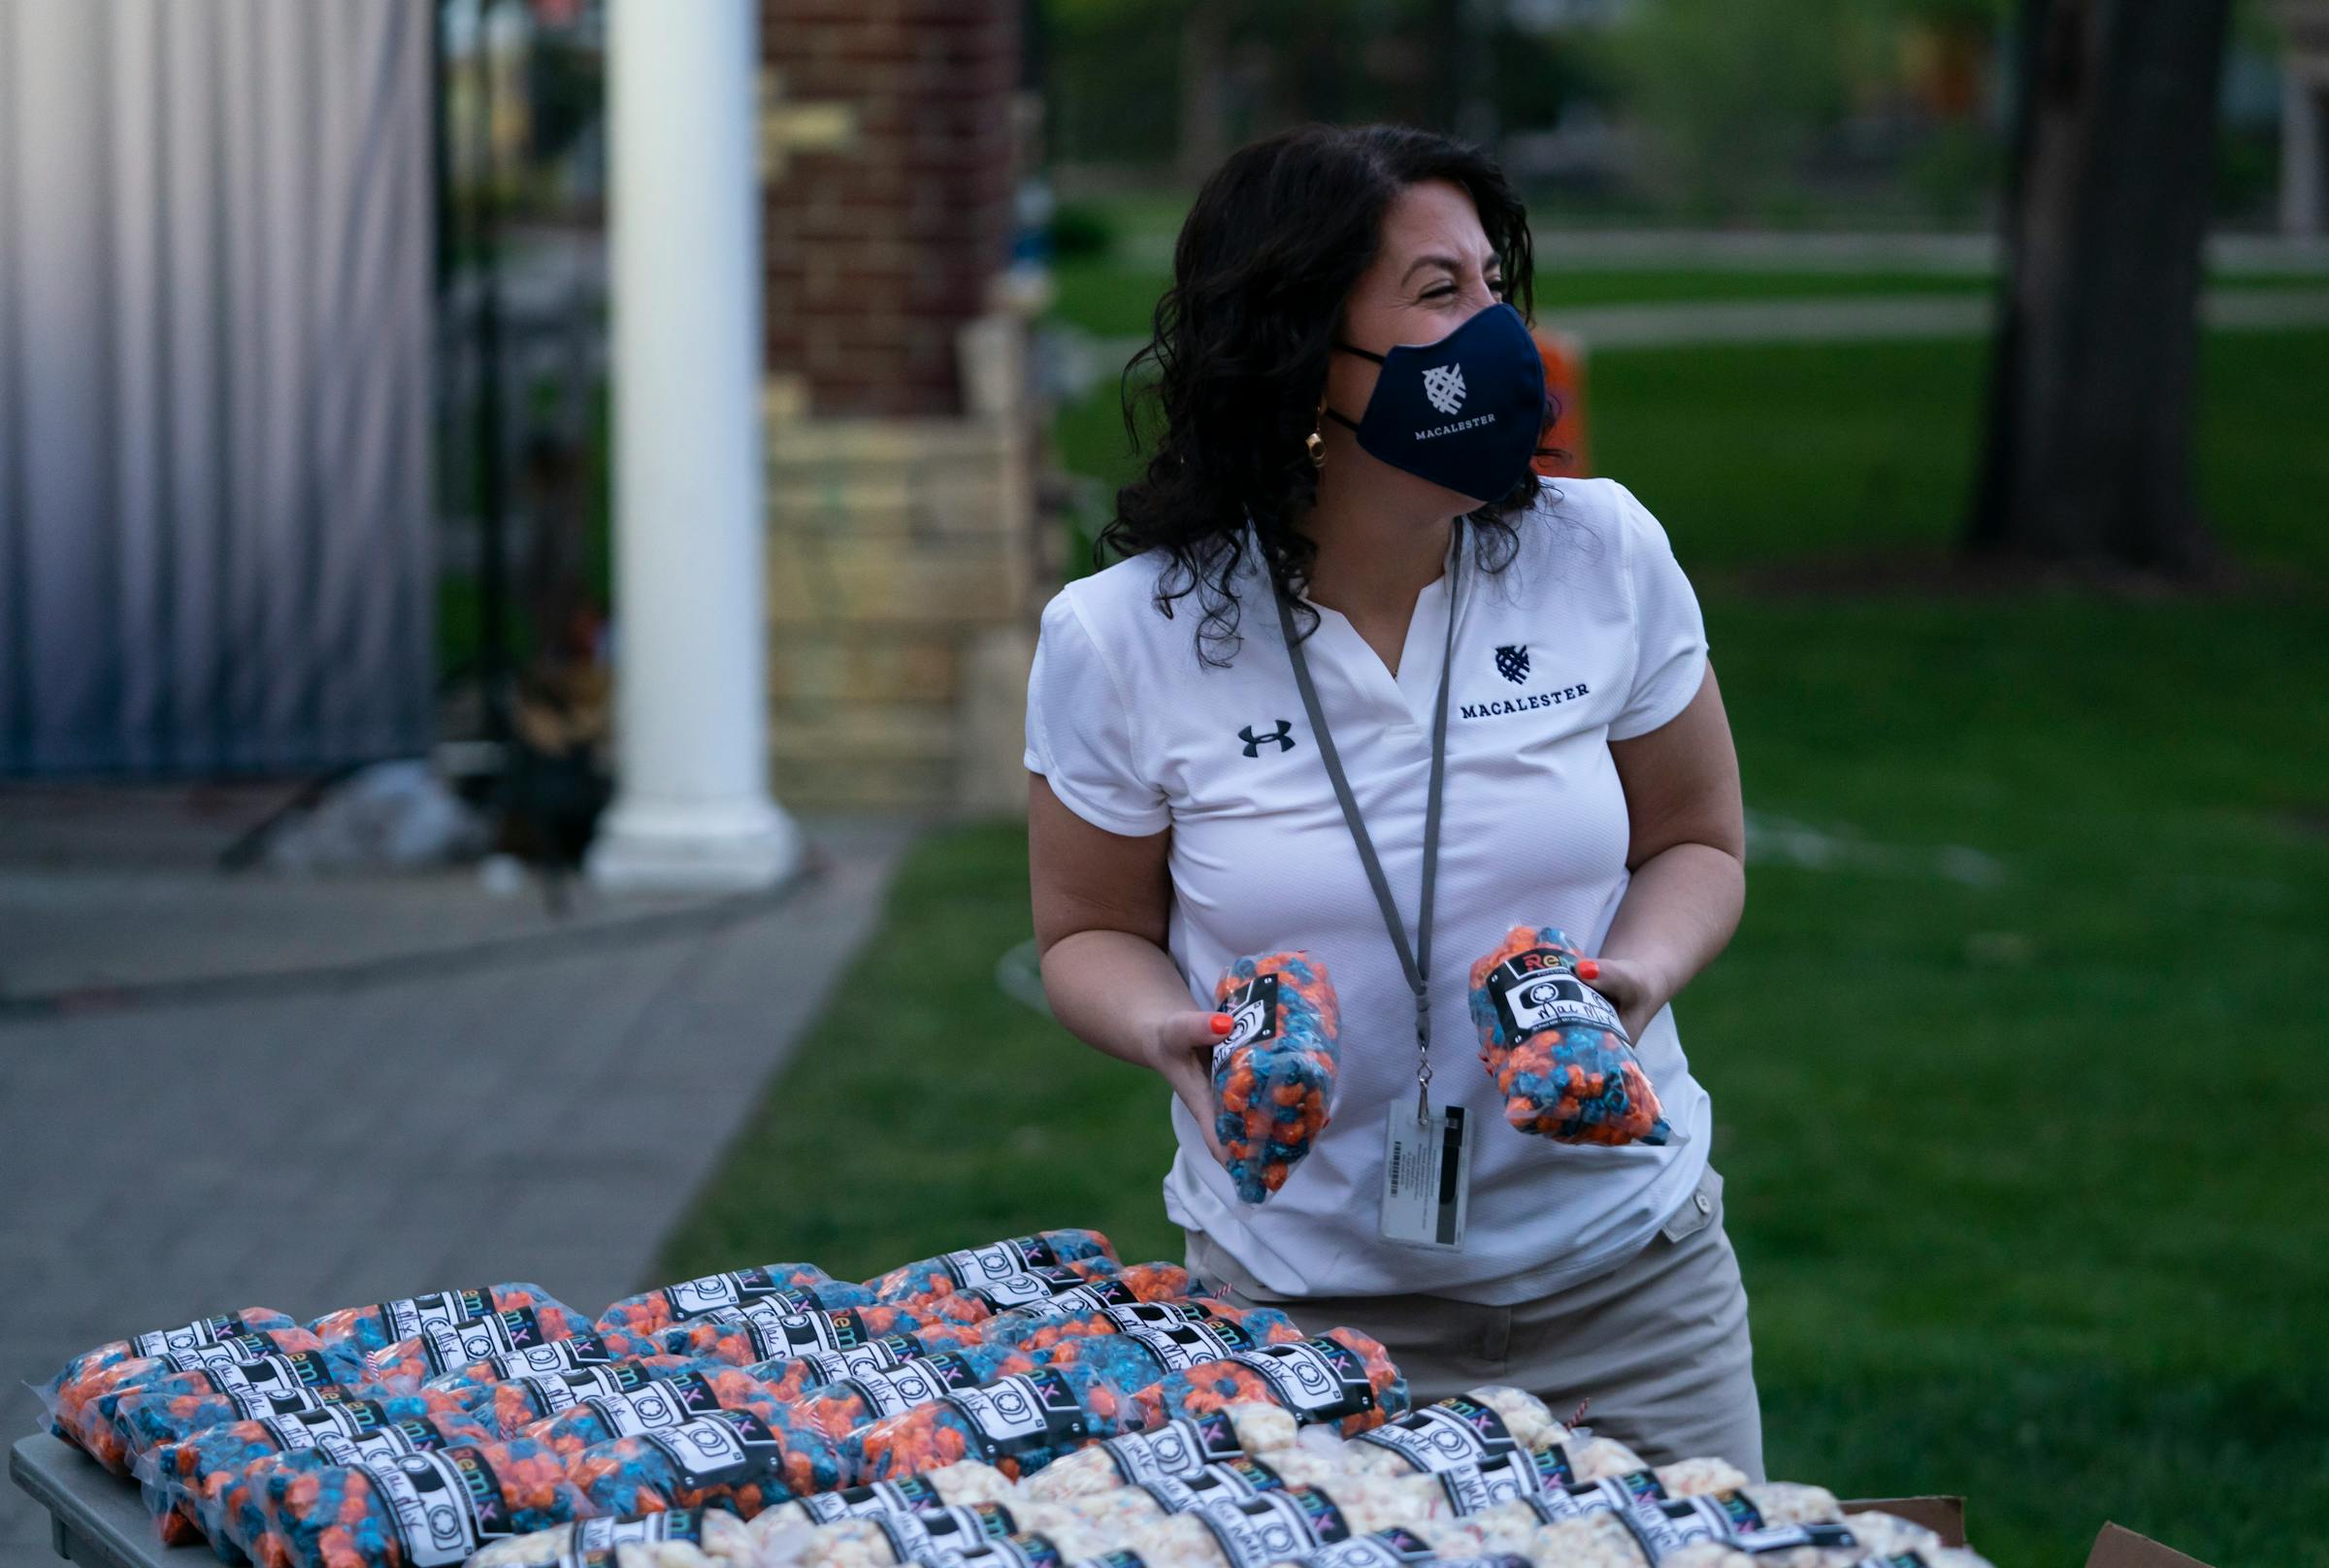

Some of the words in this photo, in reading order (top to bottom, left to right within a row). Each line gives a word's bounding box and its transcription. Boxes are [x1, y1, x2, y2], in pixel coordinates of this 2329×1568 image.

[1415, 413, 1495, 440] MACALESTER
[1461, 683, 1591, 719] MACALESTER
[447, 1447, 498, 1522] Remix
